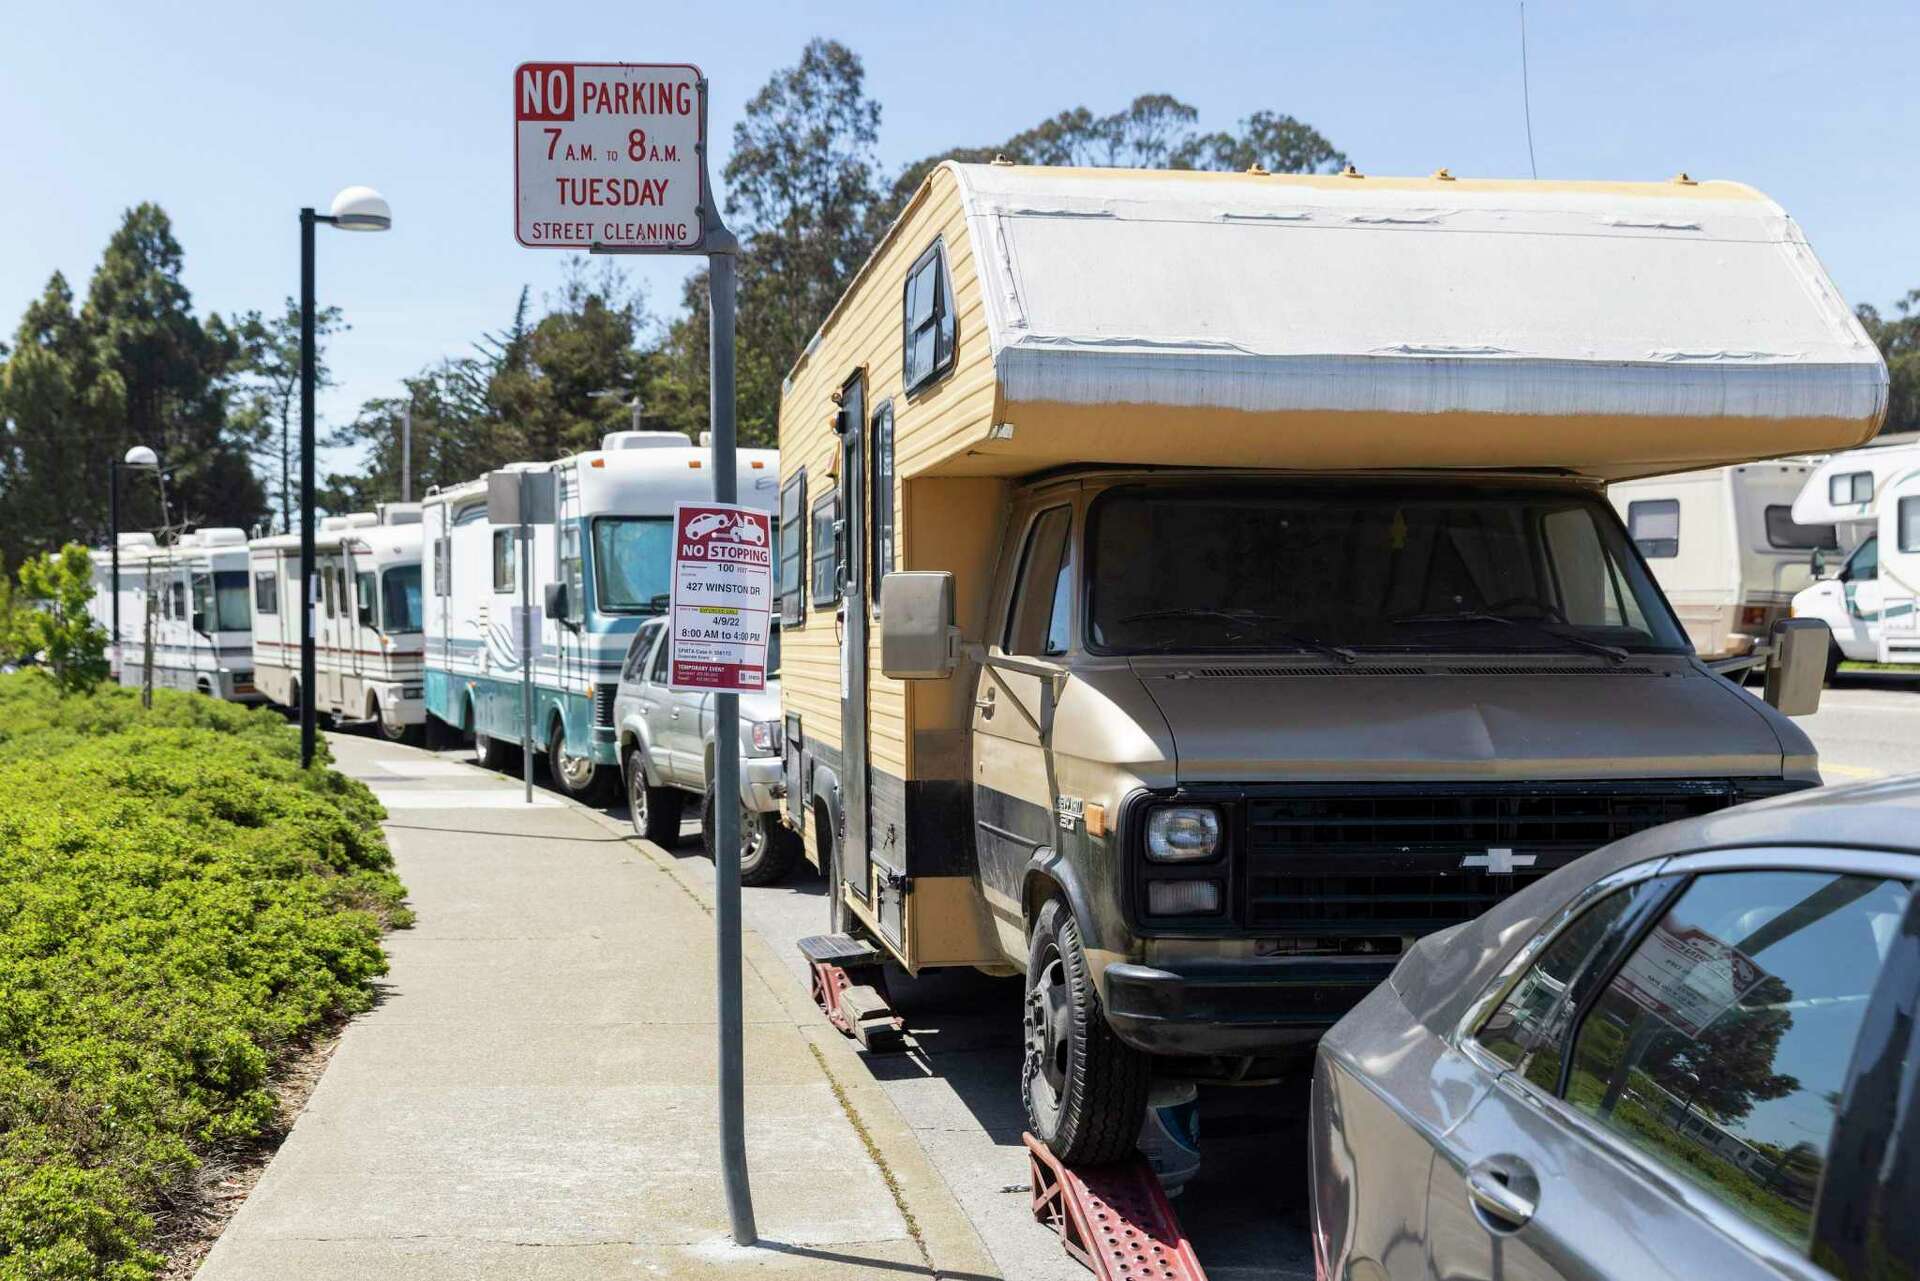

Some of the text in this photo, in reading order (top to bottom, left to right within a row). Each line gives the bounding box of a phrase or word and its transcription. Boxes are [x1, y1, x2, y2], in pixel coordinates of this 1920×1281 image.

[522, 69, 692, 116] NO PARKING
[543, 127, 563, 161] 7
[565, 143, 598, 162] A.M.
[606, 150, 619, 162] TO
[627, 128, 647, 162] 8
[556, 177, 670, 207] TUESDAY
[532, 222, 688, 241] STREET CLEANING
[682, 544, 768, 562] NO STOPPING
[718, 563, 734, 573] 100
[686, 582, 761, 596] 427 WINSTON DR
[712, 616, 740, 627] 4/9/22
[681, 628, 760, 642] 8:00 AM to 4:00 PM
